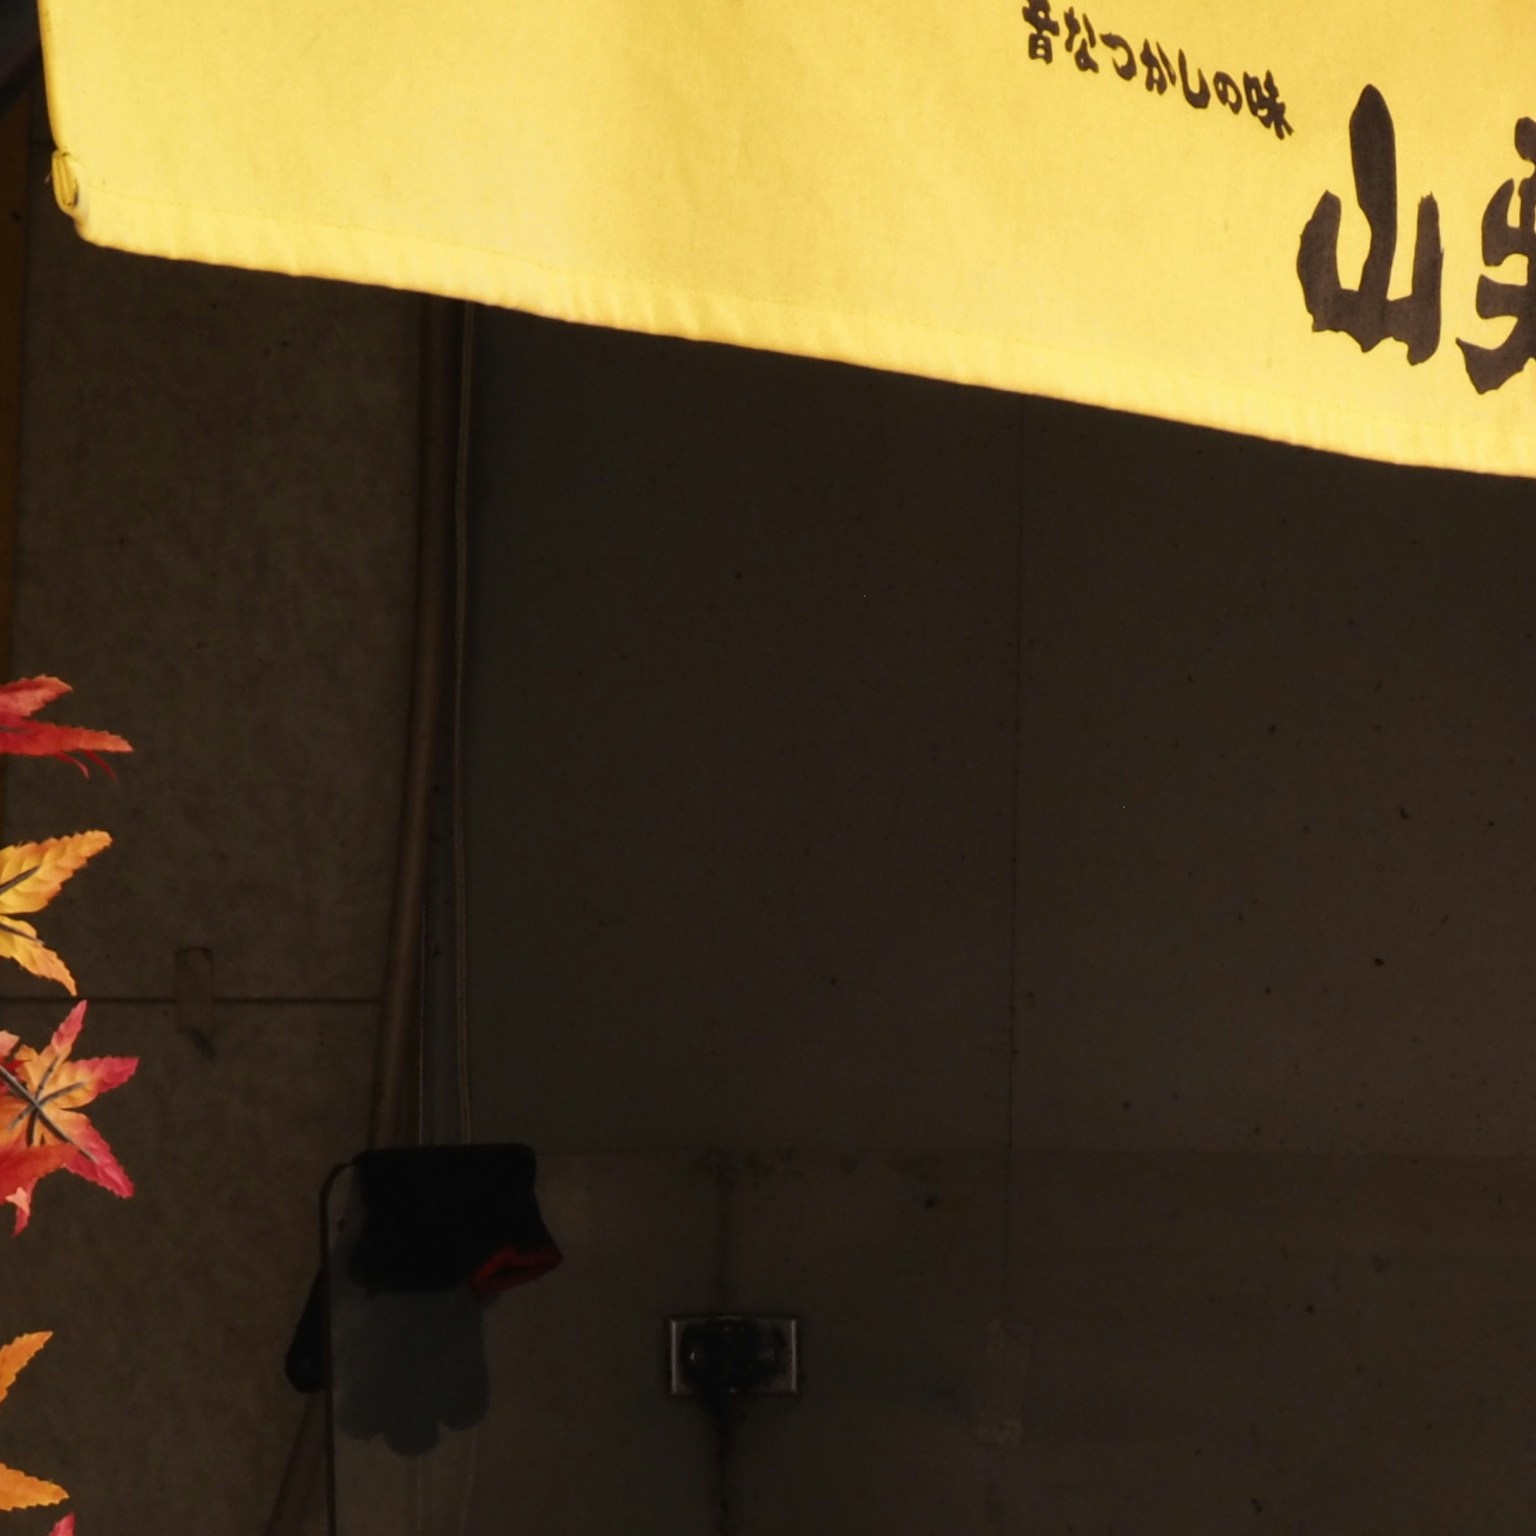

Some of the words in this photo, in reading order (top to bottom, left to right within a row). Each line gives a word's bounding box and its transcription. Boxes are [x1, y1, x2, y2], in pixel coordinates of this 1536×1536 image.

[1022, 0, 1293, 139] 昔なつかしの味
